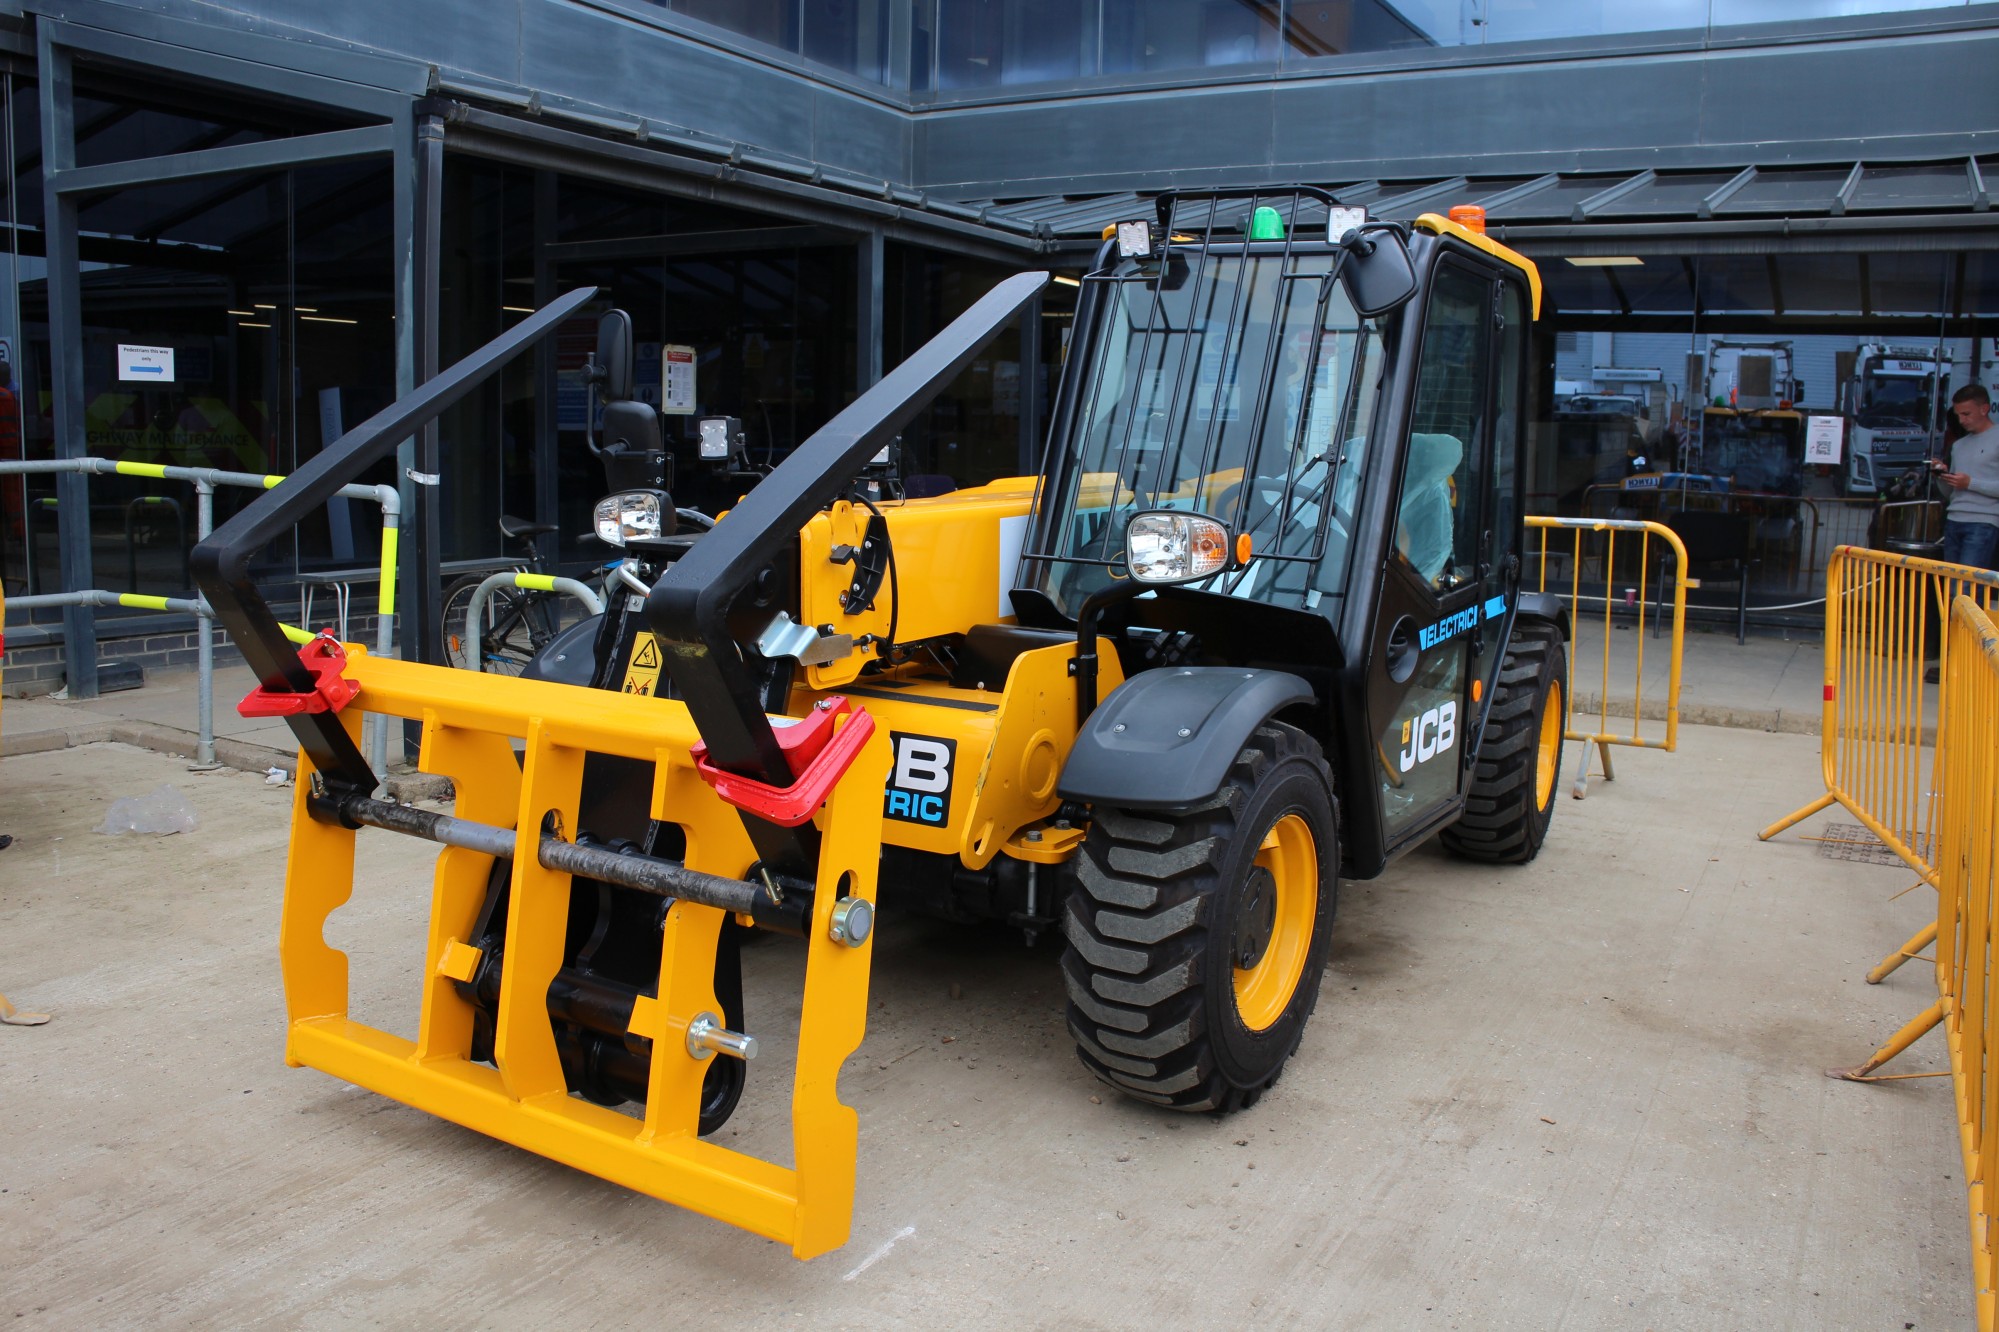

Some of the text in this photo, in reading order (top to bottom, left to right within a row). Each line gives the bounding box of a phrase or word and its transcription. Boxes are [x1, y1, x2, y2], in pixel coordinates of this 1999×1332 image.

[86, 430, 249, 446] GHWAY MAINTENANCE
[1425, 608, 1475, 648] ELECTRIC
[1400, 700, 1456, 773] JCB
